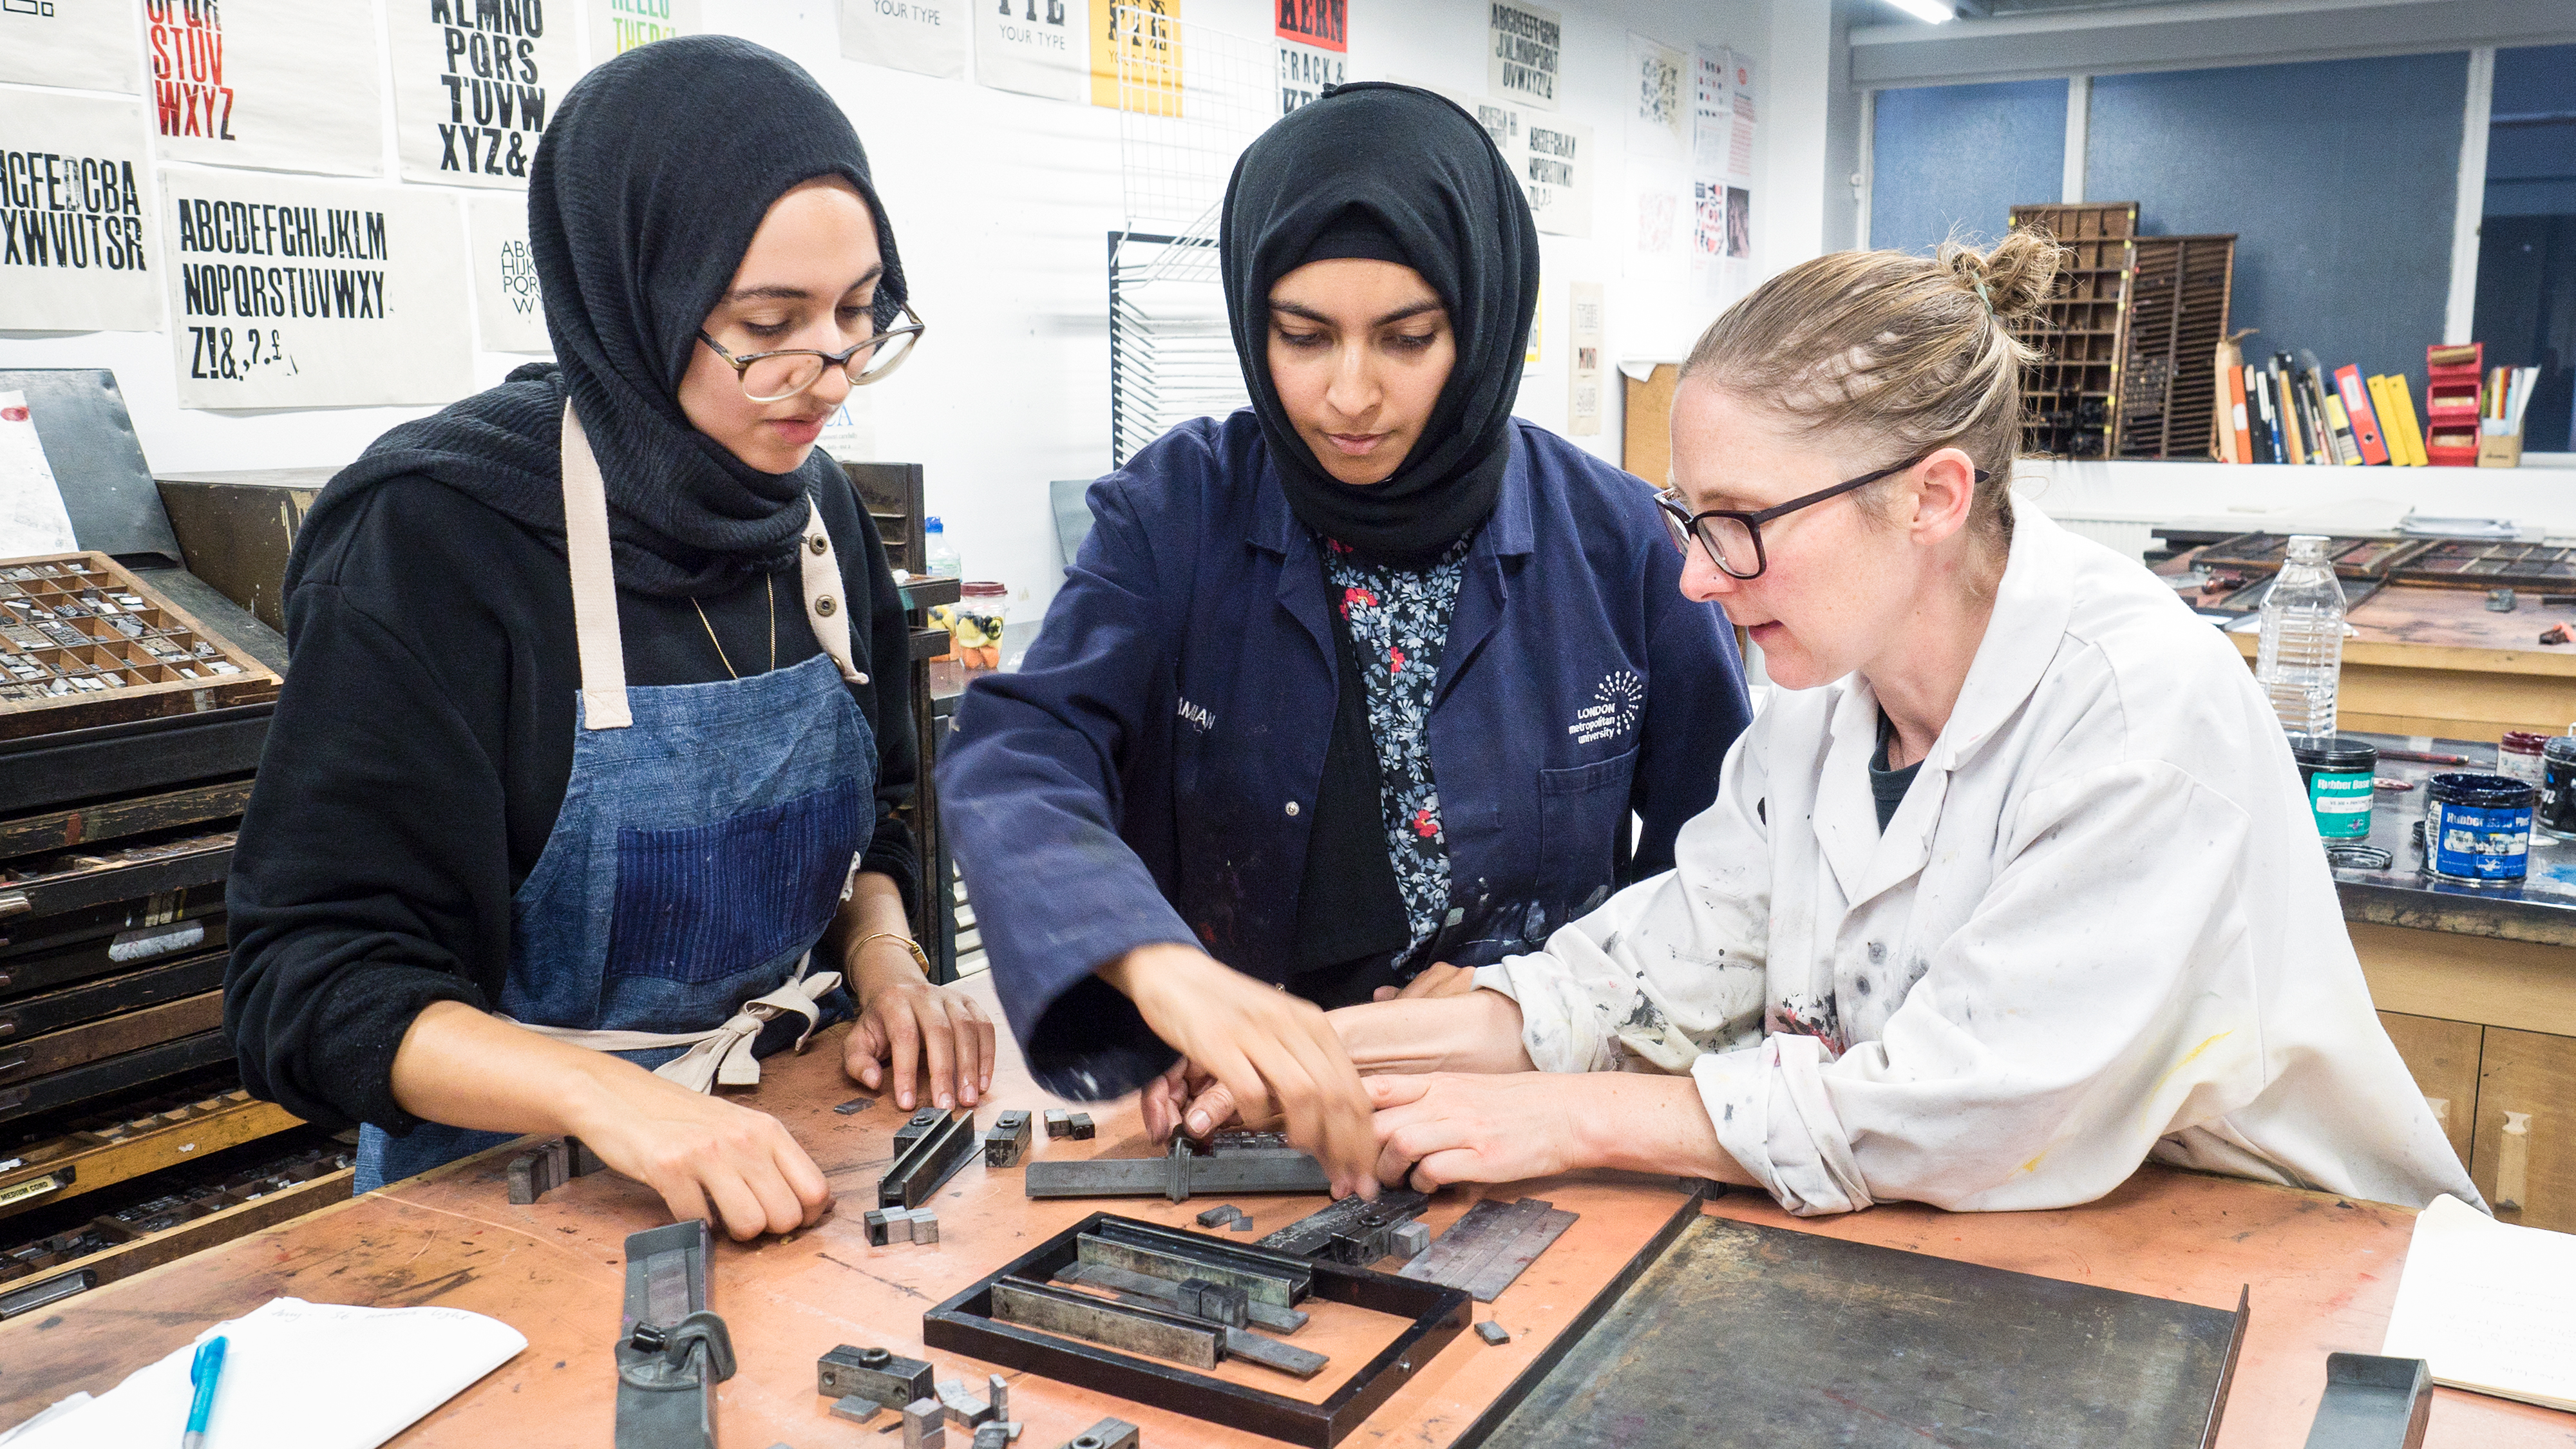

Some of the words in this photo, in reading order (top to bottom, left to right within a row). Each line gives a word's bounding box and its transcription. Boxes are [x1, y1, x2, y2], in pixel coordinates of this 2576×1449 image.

[874, 0, 908, 19] YOUR
[912, 6, 941, 26] TYPE
[151, 24, 222, 86] STUV
[444, 26, 538, 85] PQRS
[999, 24, 1032, 43] YOUR
[1037, 32, 1066, 50] TYPE
[1280, 49, 1331, 85] TRACK
[155, 79, 236, 141] WXYZ
[0, 209, 147, 271] XWVUTSR
[178, 199, 388, 260] ABCDEFGHIJKLM
[183, 263, 384, 319] NOPQRSTUVWXY
[1569, 716, 1615, 734] metropolitan
[1577, 703, 1615, 719] LONDON
[1578, 727, 1615, 744] university
